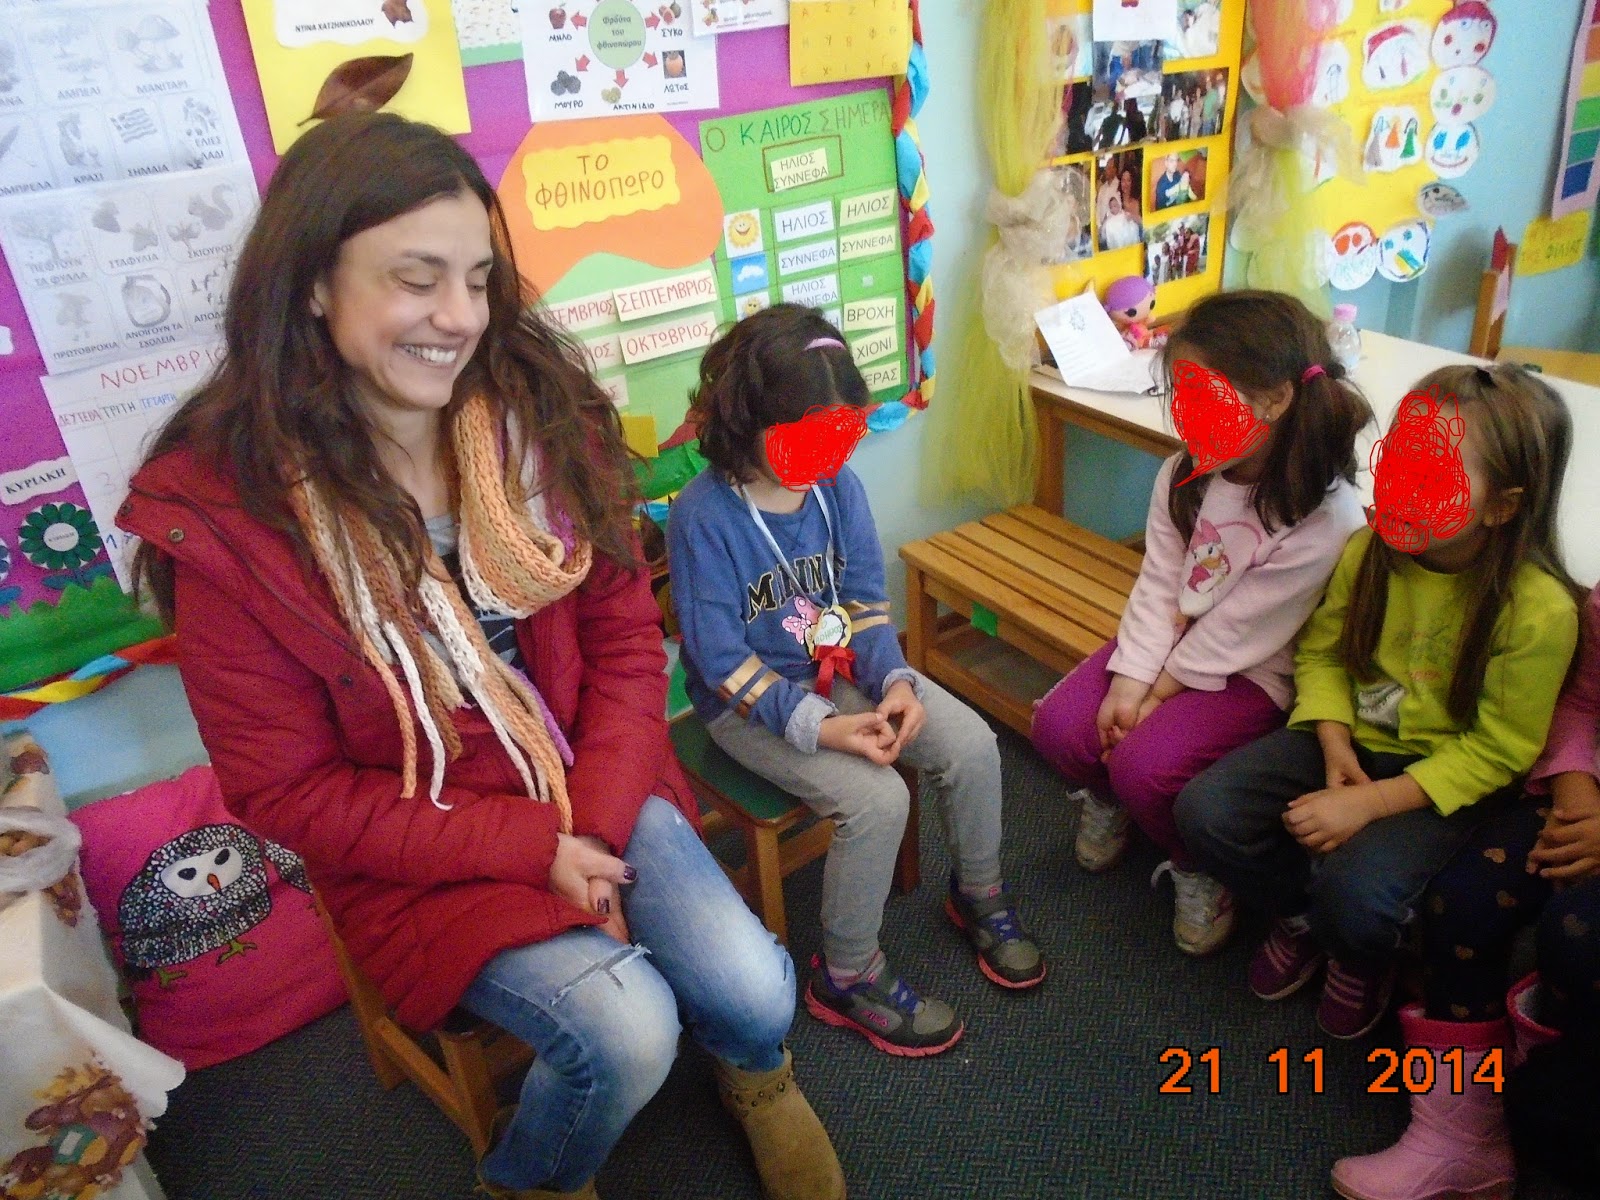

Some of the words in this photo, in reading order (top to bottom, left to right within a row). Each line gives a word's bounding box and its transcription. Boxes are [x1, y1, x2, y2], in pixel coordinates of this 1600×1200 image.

[549, 34, 573, 42] ΜΗΛΟ
[612, 28, 625, 36] του
[661, 28, 683, 37] ΣΥΚΟ
[597, 40, 642, 51] φθινοπώρου
[664, 83, 689, 93] ΛΩΤΟΣ
[554, 100, 584, 109] ΜΟΥΡΟ
[613, 102, 655, 111] ΑΚΤΙΝΙΔΙΟ
[706, 127, 725, 152] Ο
[740, 111, 813, 146] ΚΑΙΡΟΣ
[818, 99, 891, 134] ΣΗΜΕΡΑ
[128, 164, 169, 177] ΣΗΜΑΙΑ
[577, 154, 609, 175] ΤΟ
[780, 153, 816, 172] ΗΛΙΟΣ
[773, 165, 829, 190] ΣΥΝΝΕΦΑ
[847, 195, 890, 218] ΗΛΙΟΣ
[781, 210, 830, 233] ΗΛΙΟΣ
[187, 245, 233, 259] ΣΚΙΟΥΡΟΣ
[842, 233, 894, 253] ΣΥΝΝΕΦΑ
[109, 253, 159, 269] ΣΤΑΦΥΛΙΑ
[781, 246, 836, 269] ΣΥΝΝΕΦΑ
[617, 277, 716, 314] ΣΕΠΤΕΜΒΡΙΟΣ
[791, 278, 827, 296] ΗΛΙΟΣ
[797, 291, 838, 307] ΝΝΕΦΑ
[847, 305, 895, 322] ΒΡΟΧΗ
[125, 325, 170, 340] ΑΝΟΙΓΟΥΝ
[626, 321, 713, 357] ΟΚΤΩΒΡΙΟΣ
[53, 341, 119, 360] ΠΡΩΤΟΒΡΟΧΙΑ
[857, 336, 893, 361] ΧΙΟΝΙ
[864, 367, 898, 387] ΕΡΑΣ
[102, 401, 136, 419] ΤΡΙΤΗ
[5, 468, 66, 495] ΚΥΡΙΑΚΗ
